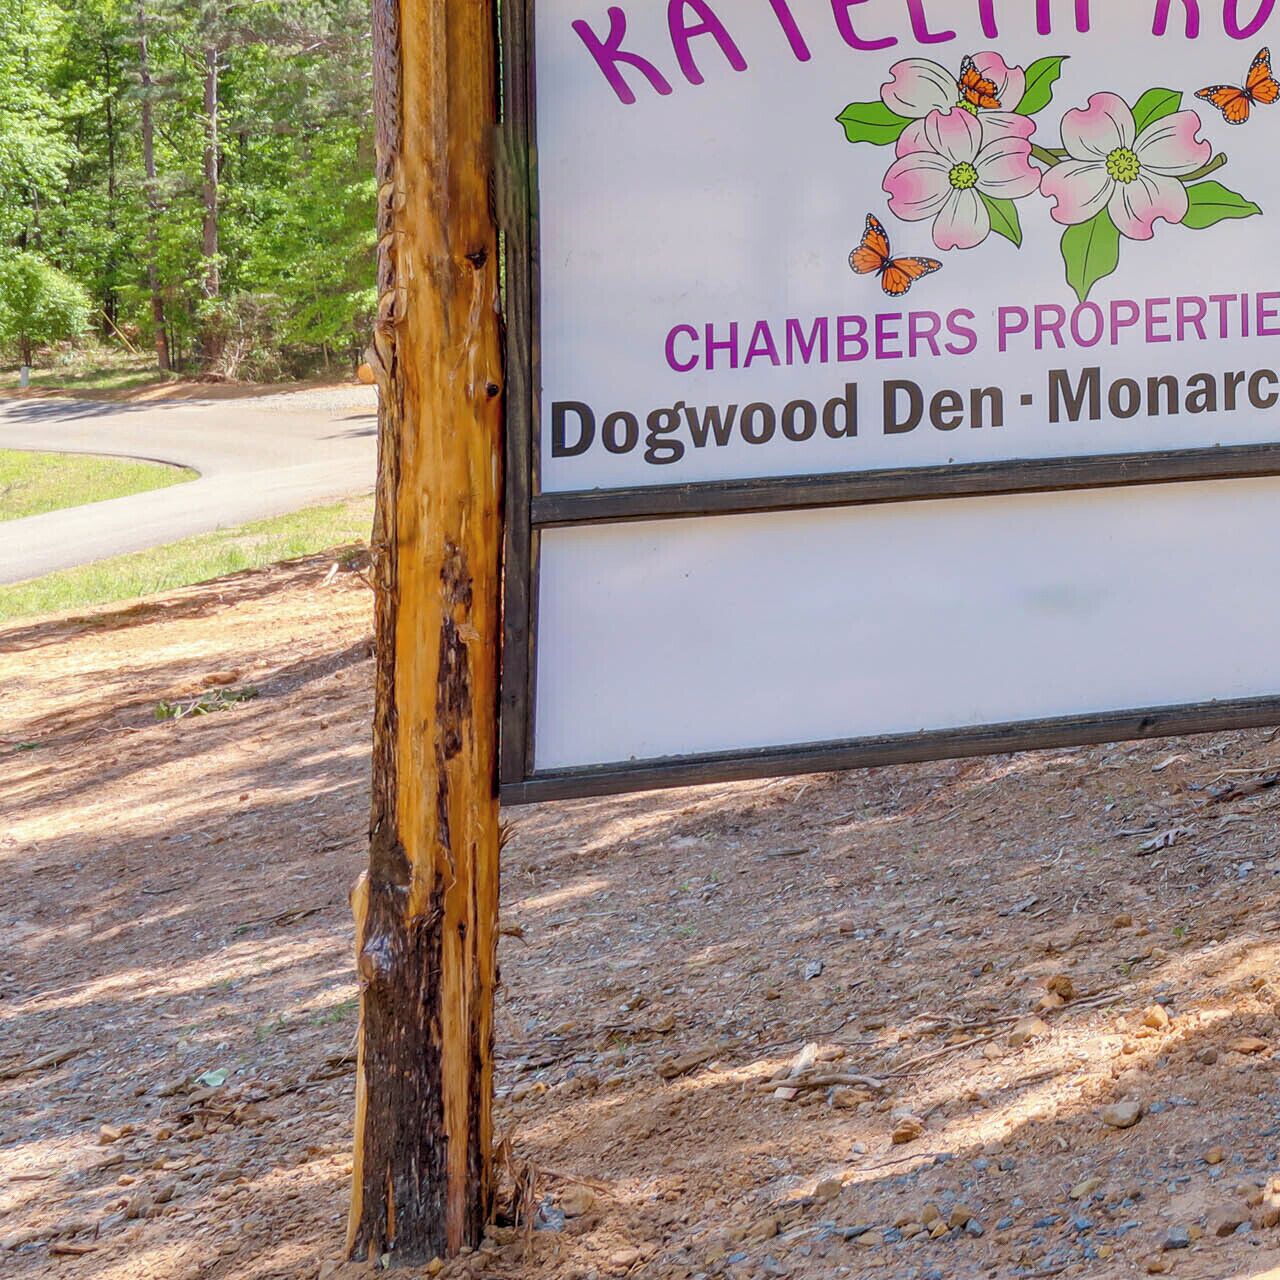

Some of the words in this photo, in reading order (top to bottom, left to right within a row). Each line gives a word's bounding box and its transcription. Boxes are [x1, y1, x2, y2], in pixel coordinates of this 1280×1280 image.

[665, 309, 977, 372] CHAMBERS
[551, 383, 857, 465] Dogwood
[883, 380, 1003, 434] Den
